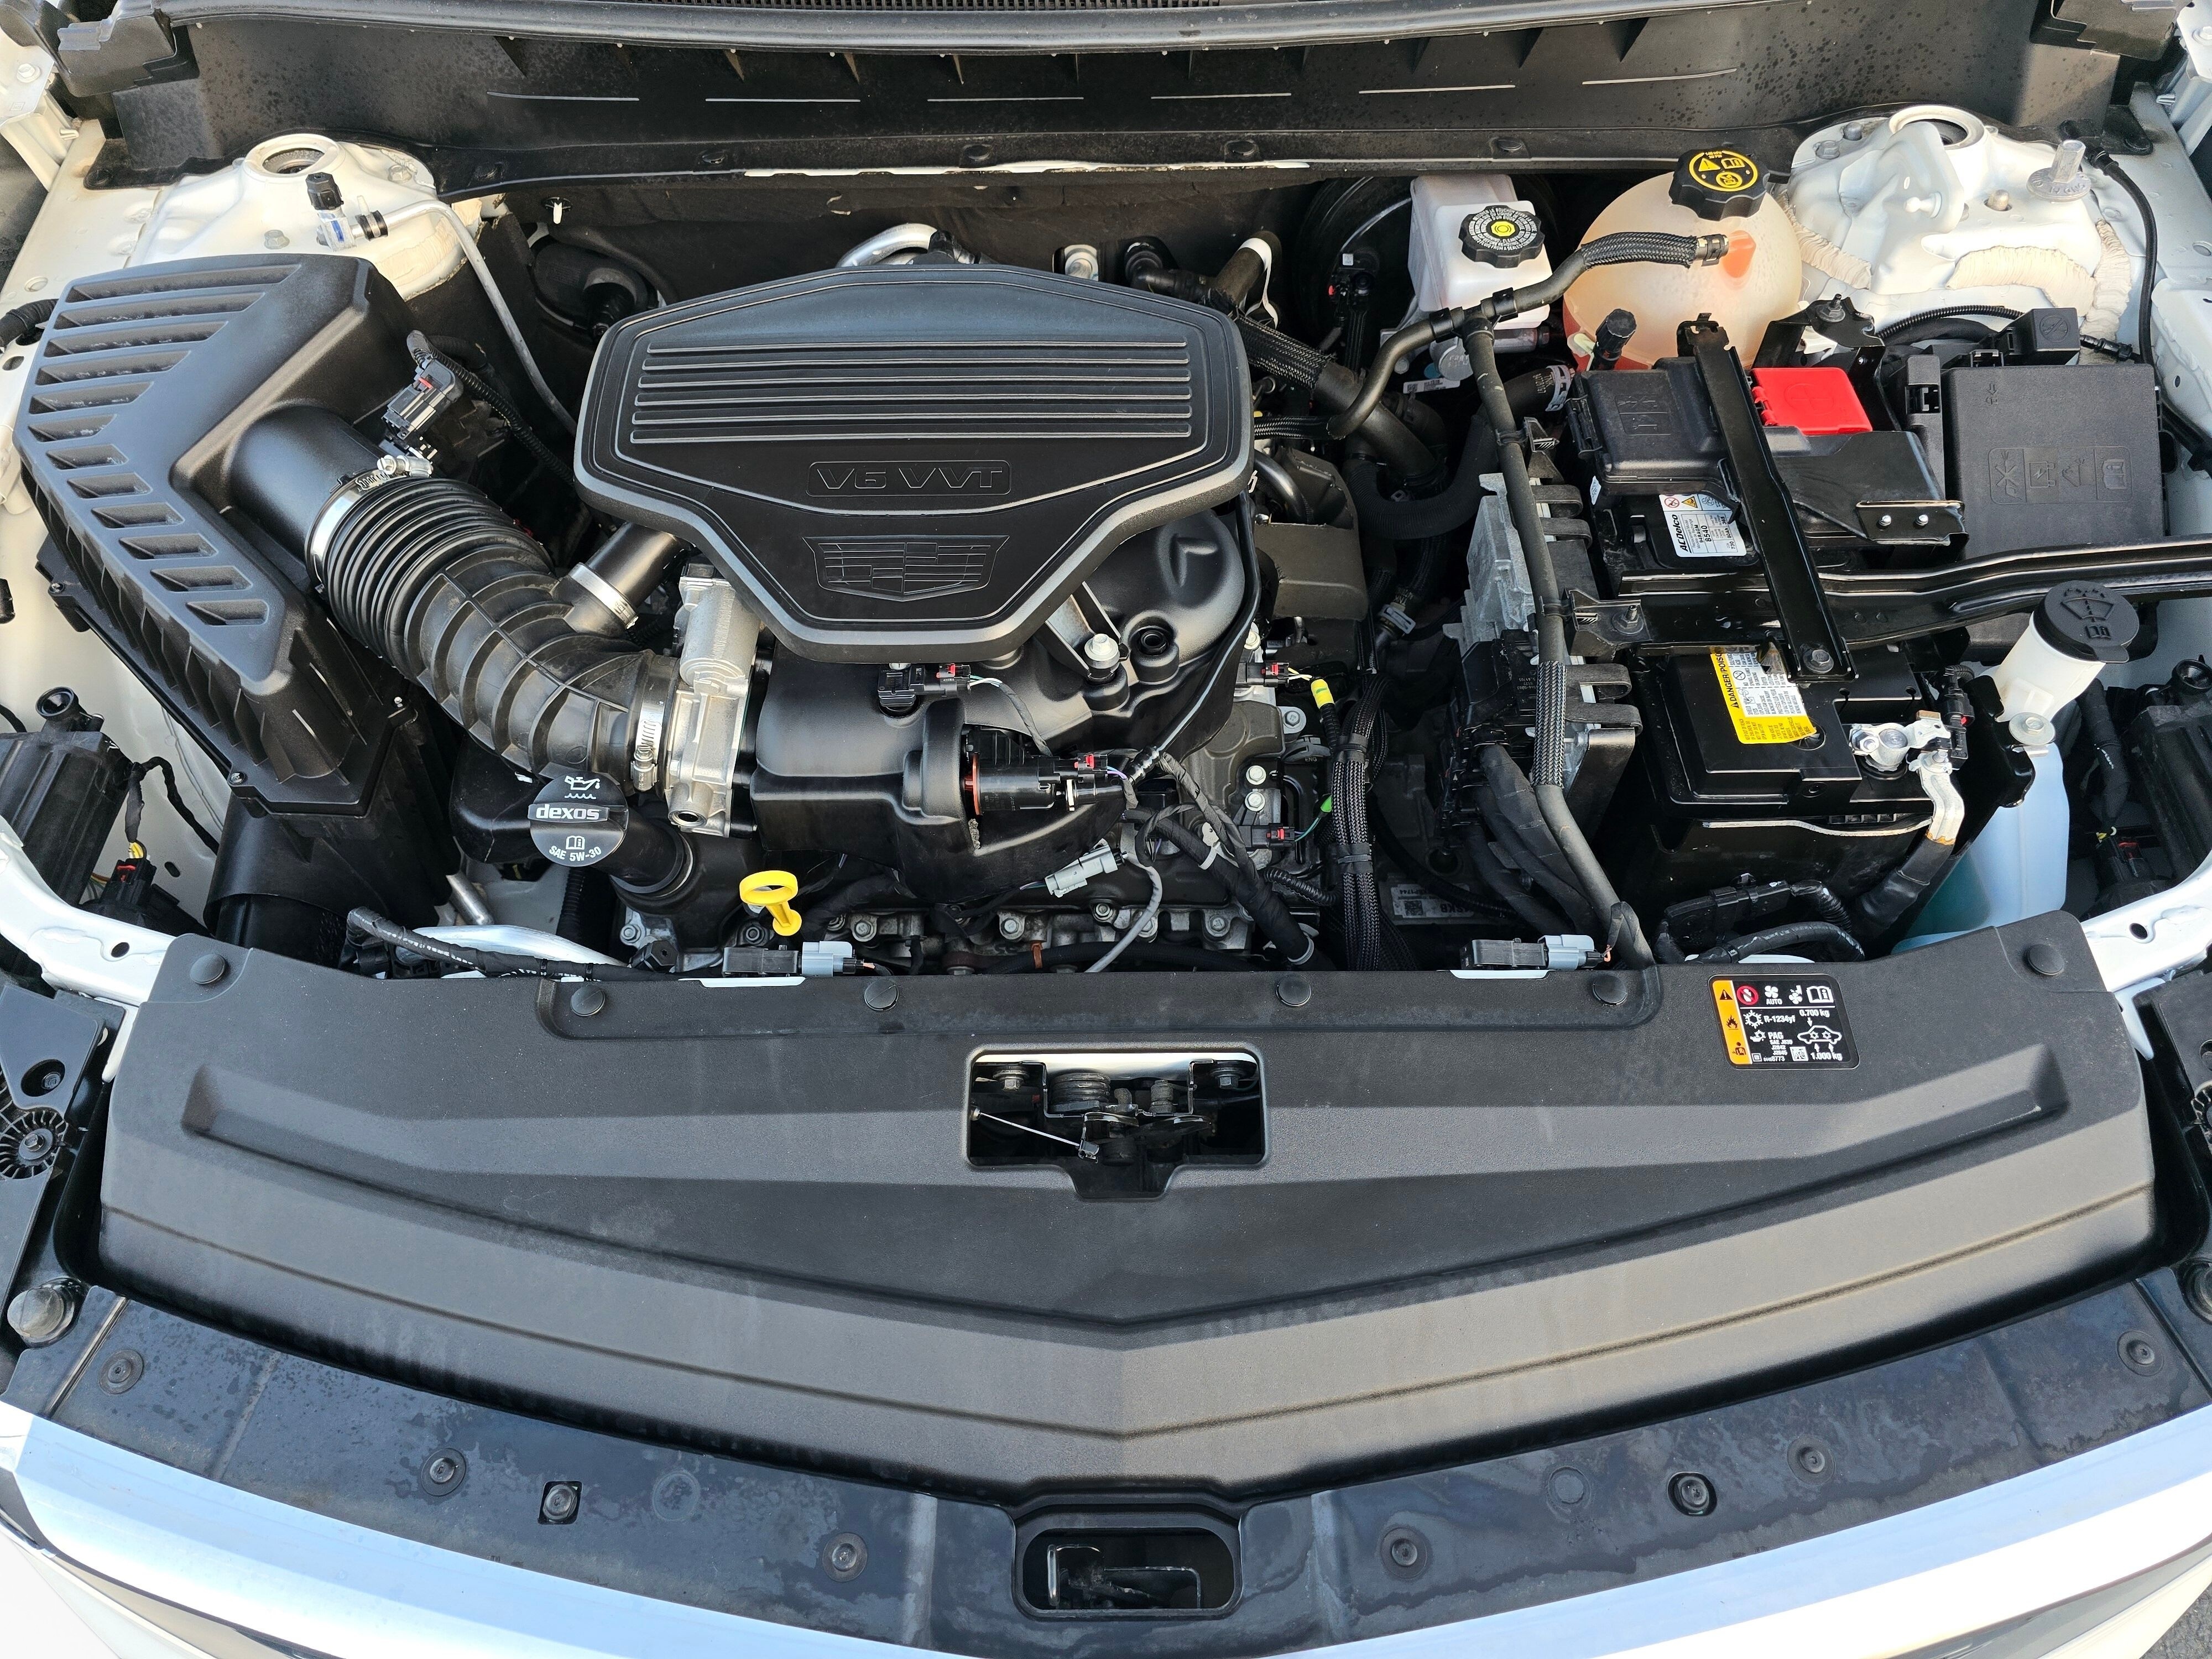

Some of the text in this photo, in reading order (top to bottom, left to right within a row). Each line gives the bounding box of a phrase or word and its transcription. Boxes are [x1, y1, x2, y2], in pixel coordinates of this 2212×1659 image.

[817, 467, 1003, 489] V6 VVT
[1672, 514, 1688, 552] ACDelco
[1694, 524, 1704, 543] 94RAGM
[1701, 525, 1712, 541] 8540
[1715, 653, 1738, 701] DANGER/POISO
[536, 804, 599, 820] dexos
[549, 846, 602, 862] SAE 5W-30
[1763, 1015, 1796, 1024] R-1234yf
[1819, 1009, 1830, 1018] kg
[1832, 1052, 1843, 1061] kg
